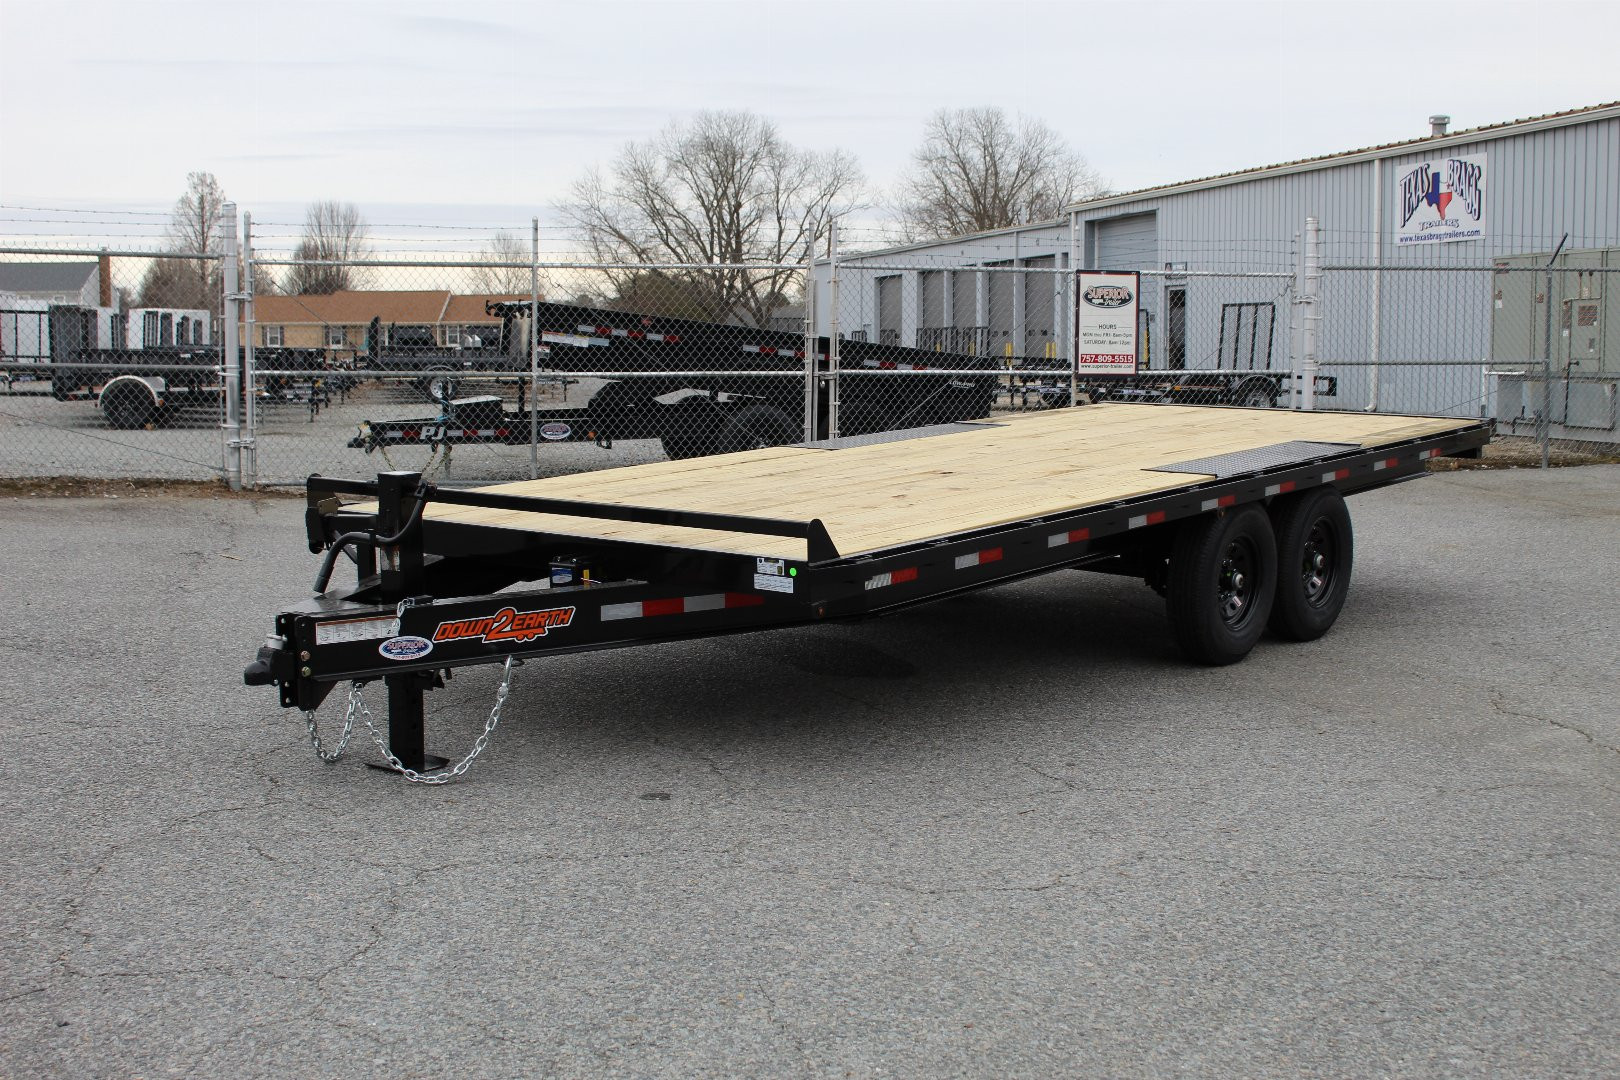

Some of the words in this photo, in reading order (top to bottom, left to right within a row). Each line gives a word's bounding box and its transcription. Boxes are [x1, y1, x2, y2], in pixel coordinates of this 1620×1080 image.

[1400, 163, 1430, 228] TEXAS
[1446, 159, 1481, 221] BRAGG
[1419, 220, 1460, 231] TRAILERS
[1088, 286, 1129, 300] SUPERIOR
[420, 426, 446, 440] PJ
